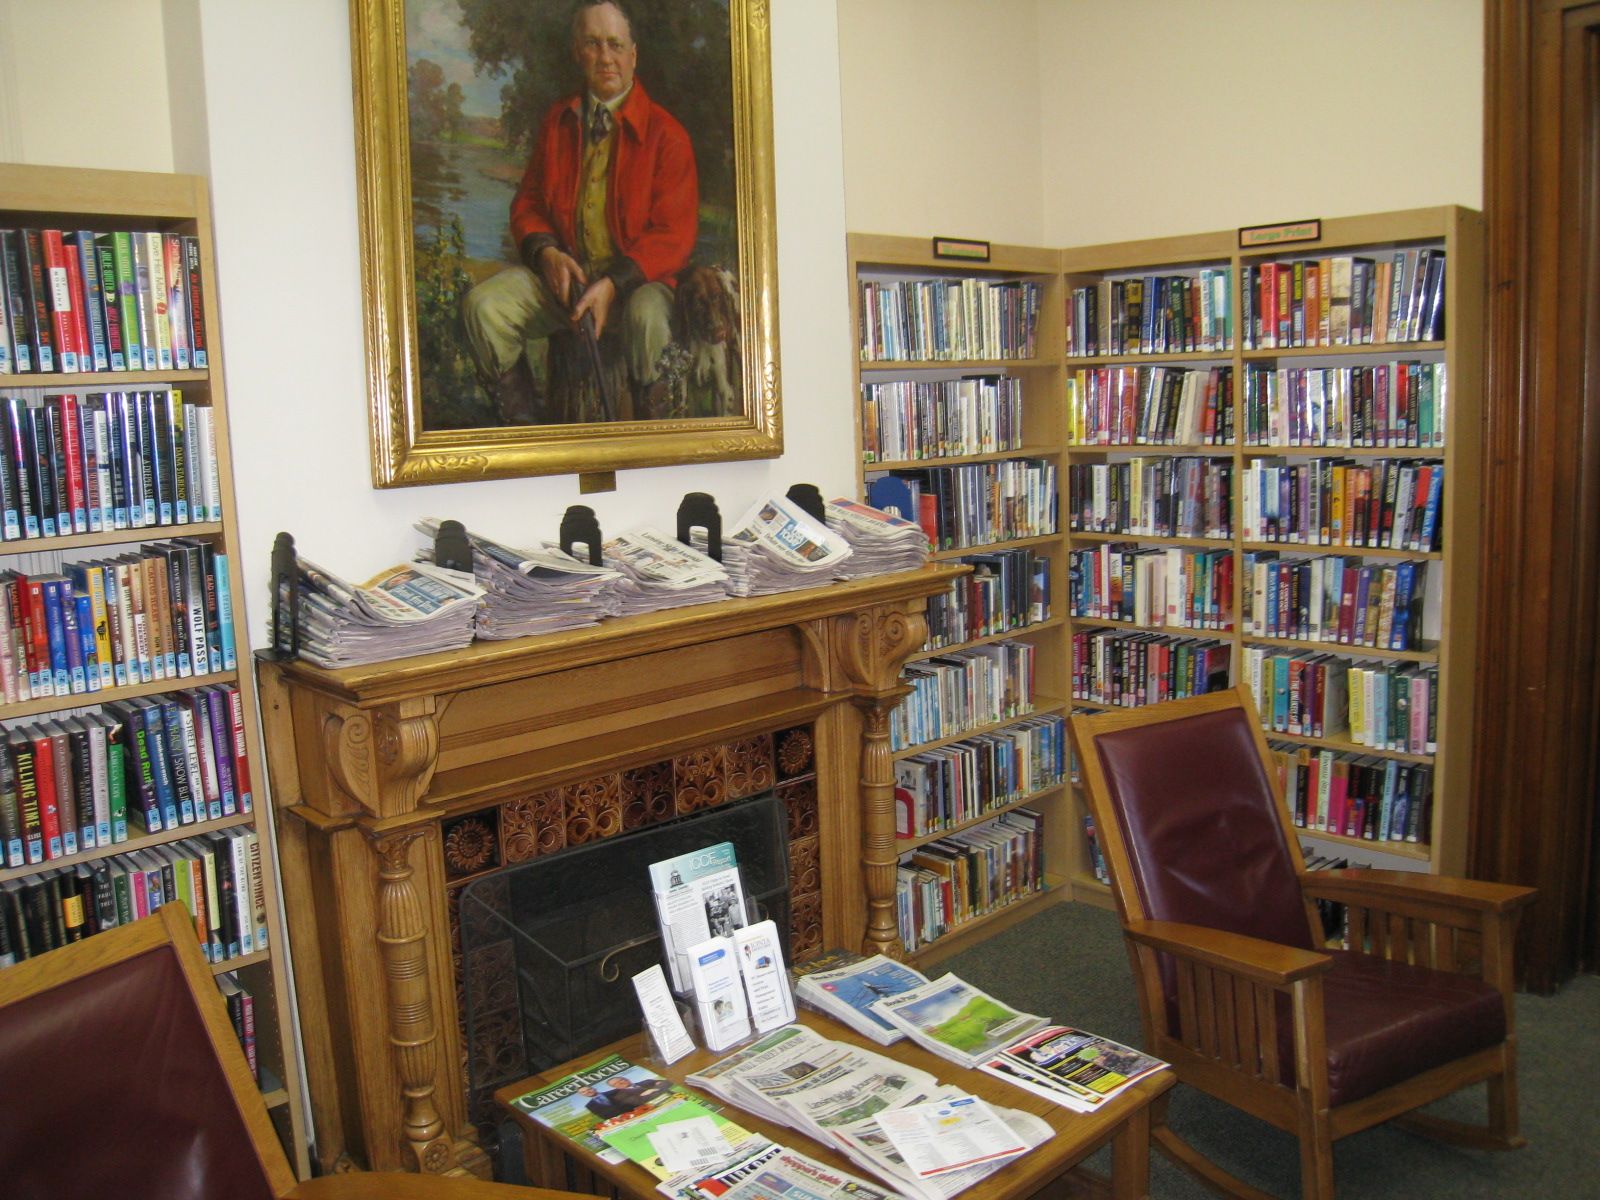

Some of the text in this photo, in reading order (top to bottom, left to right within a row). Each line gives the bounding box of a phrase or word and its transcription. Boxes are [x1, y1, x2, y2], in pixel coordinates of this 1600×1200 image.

[1283, 227, 1313, 236] Print
[102, 251, 115, 291] JULIE SMITH
[152, 236, 165, 300] Love Her Madly
[54, 271, 62, 307] MONTANA
[107, 306, 121, 350] JAZZ FUNERAL
[191, 273, 202, 348] AN AMERICAN KILLING
[53, 411, 61, 435] HUNTER'S
[83, 408, 95, 450] DANA STABENOW
[140, 403, 150, 456] DANA STABENOW
[19, 468, 30, 504] MIDNIGHT COME
[58, 477, 67, 512] DANA STABEN
[177, 468, 186, 501] STABENO
[147, 566, 157, 596] CACTUS
[2, 634, 12, 656] Hunt
[193, 608, 206, 663] WOLF PASS
[3, 659, 16, 698] Rex Stout
[1291, 680, 1299, 690] THE
[1290, 691, 1299, 714] UNLIKELY
[232, 692, 245, 757] MARGARET TRUMAN
[82, 749, 90, 773] DEATH
[136, 730, 153, 783] Dead Run
[156, 734, 168, 786] Monkeewrench
[186, 719, 198, 775] STREET LEVEL
[16, 753, 35, 799] KILLING
[58, 747, 69, 800] GRAVE CONCERNS
[84, 775, 91, 785] TO
[175, 758, 187, 784] SNOW
[85, 787, 93, 816] RECORD
[179, 786, 189, 801] BLIN
[24, 801, 40, 829] TIME
[250, 842, 264, 910] CITIZEN VINCE
[884, 993, 919, 1007] BookPage
[755, 1048, 779, 1066] STREET
[855, 1074, 882, 1092] Journal
